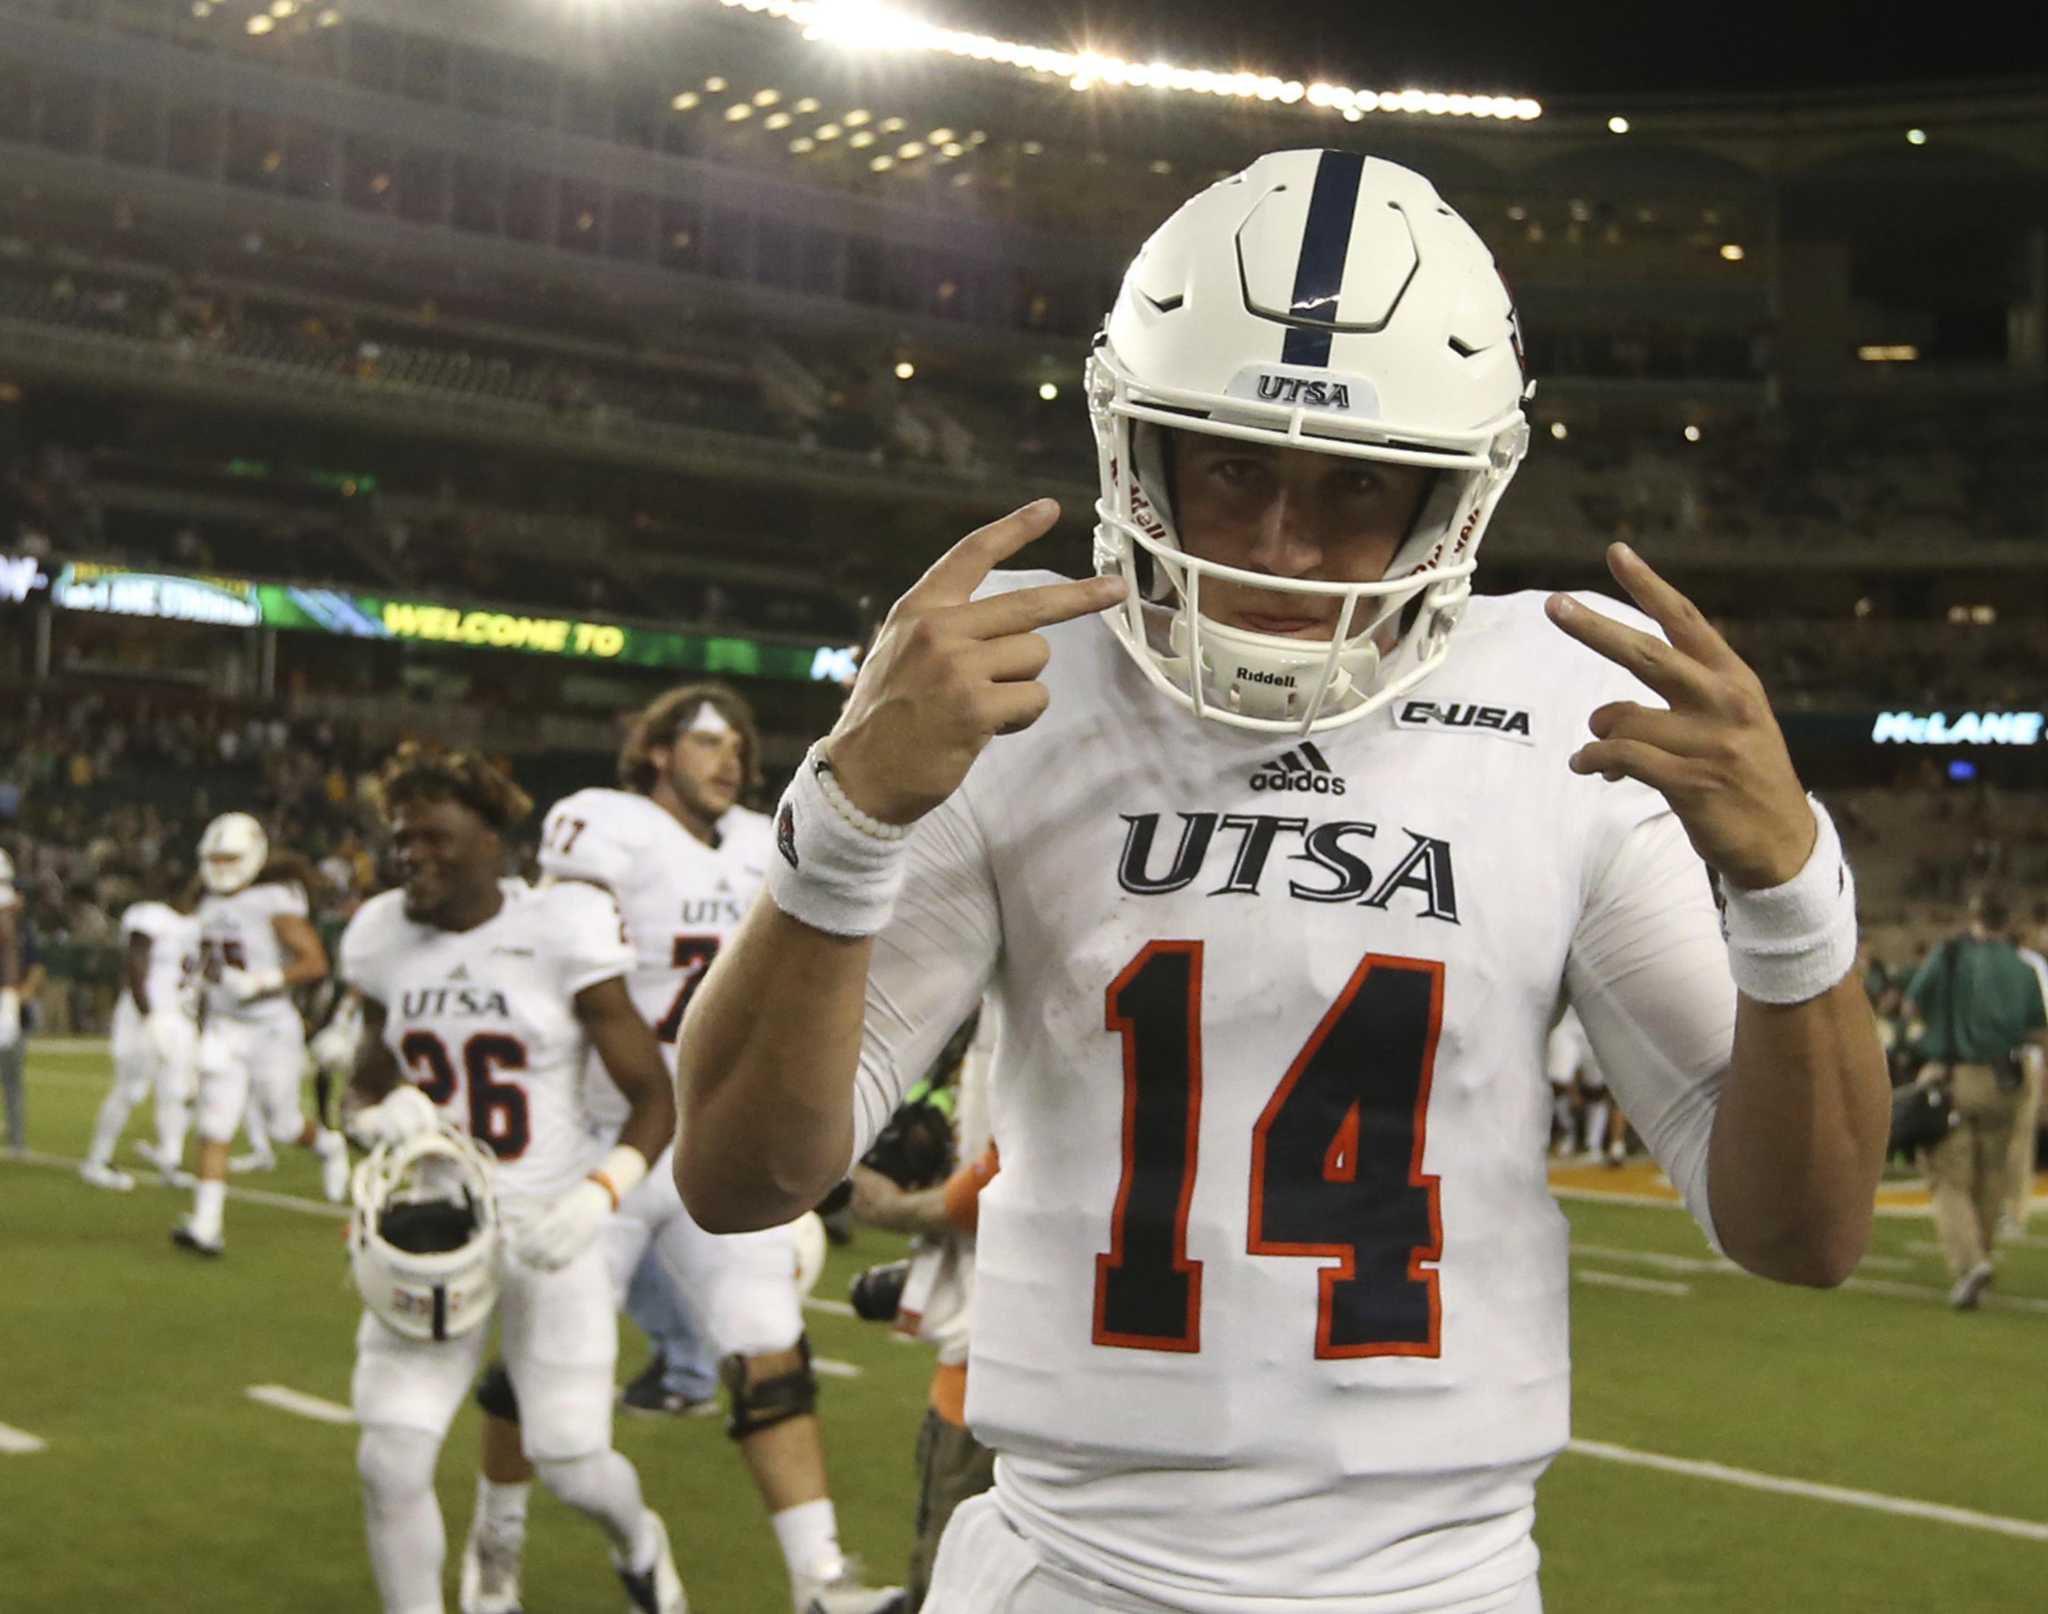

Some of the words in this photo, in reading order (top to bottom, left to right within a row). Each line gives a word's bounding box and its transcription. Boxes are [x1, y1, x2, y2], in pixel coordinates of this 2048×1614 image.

[1257, 375, 1350, 408] UTSA
[384, 602, 570, 653] WELCOME
[575, 623, 624, 657] TO
[1236, 666, 1297, 688] Riddell
[1872, 711, 2044, 745] McLANE
[1249, 770, 1346, 796] adidas
[1117, 812, 1460, 926] UTSA
[682, 899, 743, 925] UTS
[402, 989, 511, 1019] UTSA
[655, 933, 722, 1043] 7
[401, 1028, 532, 1163] 26
[1092, 939, 1446, 1360] 14
